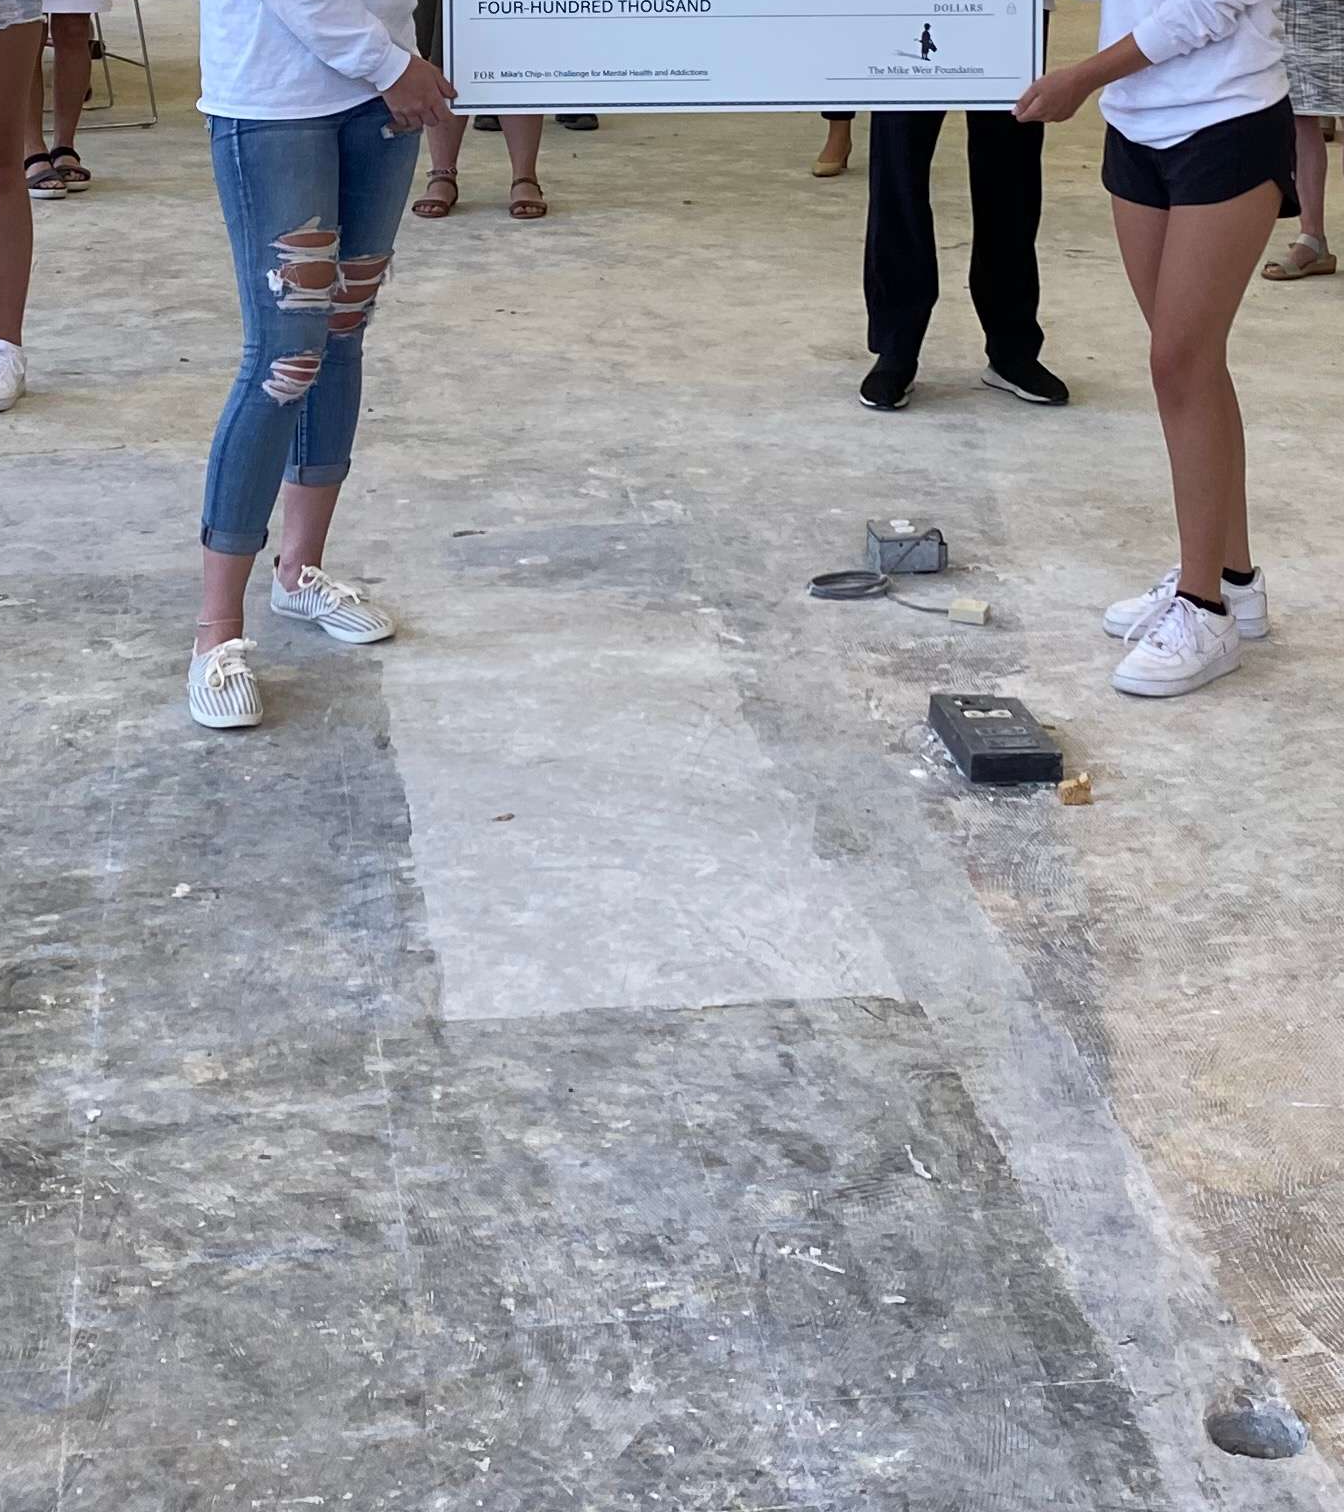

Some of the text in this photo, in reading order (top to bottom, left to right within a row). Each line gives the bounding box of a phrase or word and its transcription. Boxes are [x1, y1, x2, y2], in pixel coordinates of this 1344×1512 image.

[478, 0, 712, 14] FOUR-HUNDRED THOUSAND
[934, 3, 984, 13] DOLLARS
[473, 71, 496, 80] FOR
[553, 70, 589, 78] Challenge
[590, 69, 600, 77] for
[602, 69, 627, 77] Mental
[868, 65, 984, 74] The Mike Weir Foundation
